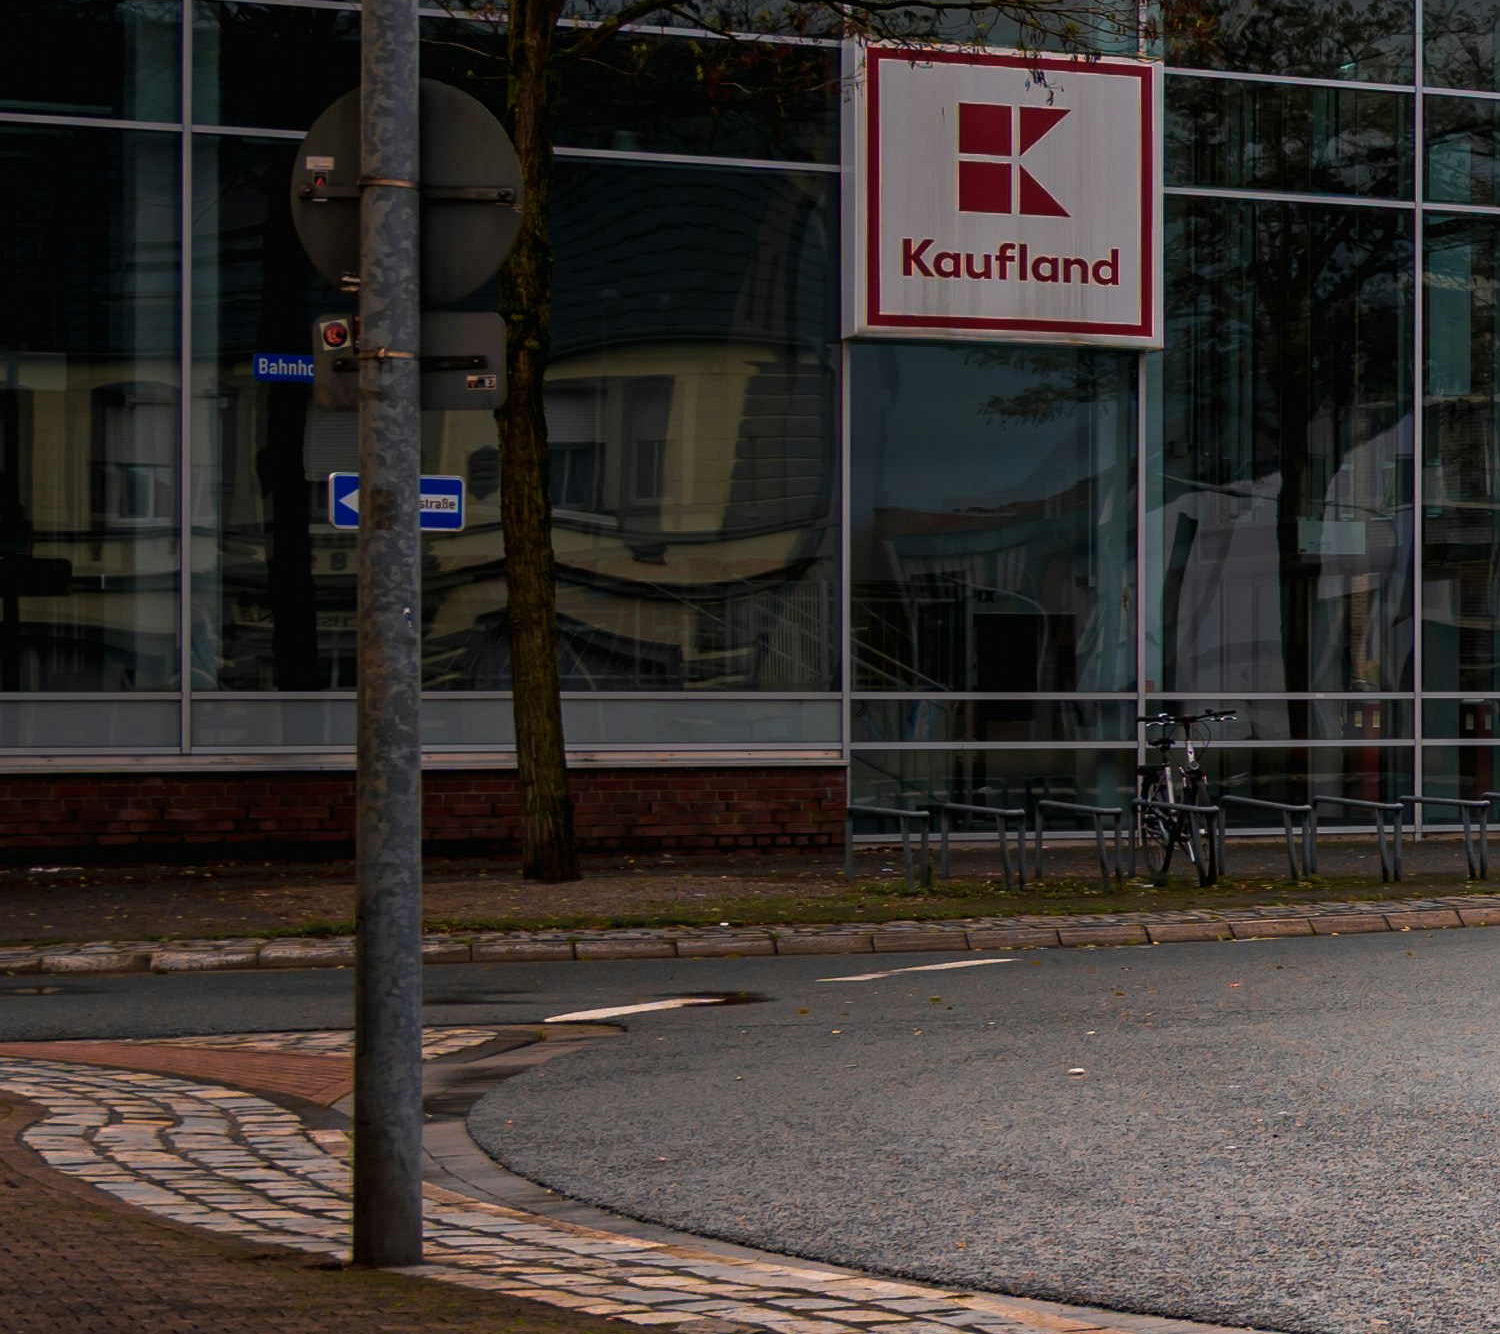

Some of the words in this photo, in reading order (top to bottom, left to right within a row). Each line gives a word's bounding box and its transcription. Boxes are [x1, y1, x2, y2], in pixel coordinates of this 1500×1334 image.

[902, 237, 1120, 286] Kaufland
[257, 357, 315, 377] Bahnho
[419, 498, 456, 509] straße
